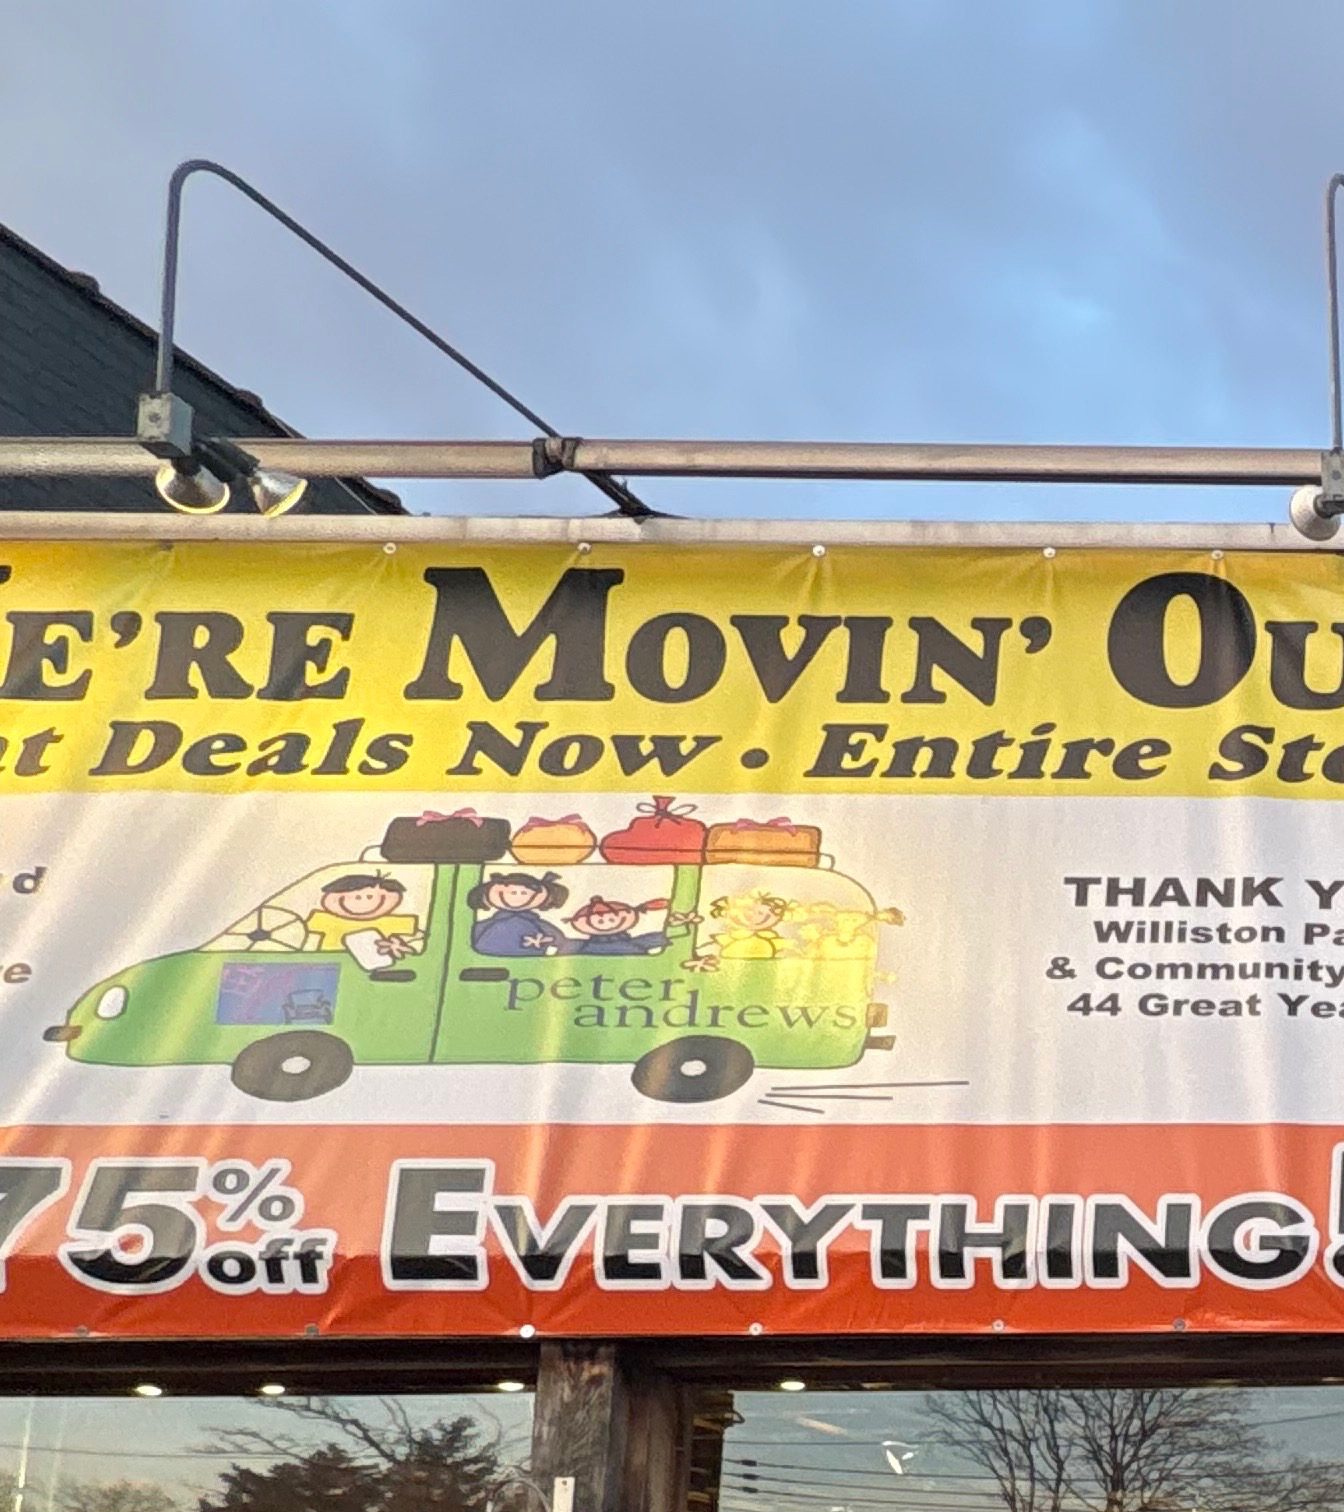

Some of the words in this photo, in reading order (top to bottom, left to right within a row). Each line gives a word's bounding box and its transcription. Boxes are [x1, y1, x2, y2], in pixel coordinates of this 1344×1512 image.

[0, 606, 354, 702] E'RE
[89, 716, 412, 779] Deals
[447, 721, 722, 778] Now
[804, 720, 1172, 781] Entire
[1065, 876, 1284, 909] THANK
[1094, 919, 1286, 946] Williston
[1045, 956, 1078, 982] &
[503, 973, 685, 1012] peter
[574, 990, 857, 1029] andrews
[1066, 992, 1121, 1019] 44
[1138, 992, 1262, 1019] Great
[207, 1238, 325, 1286] off
